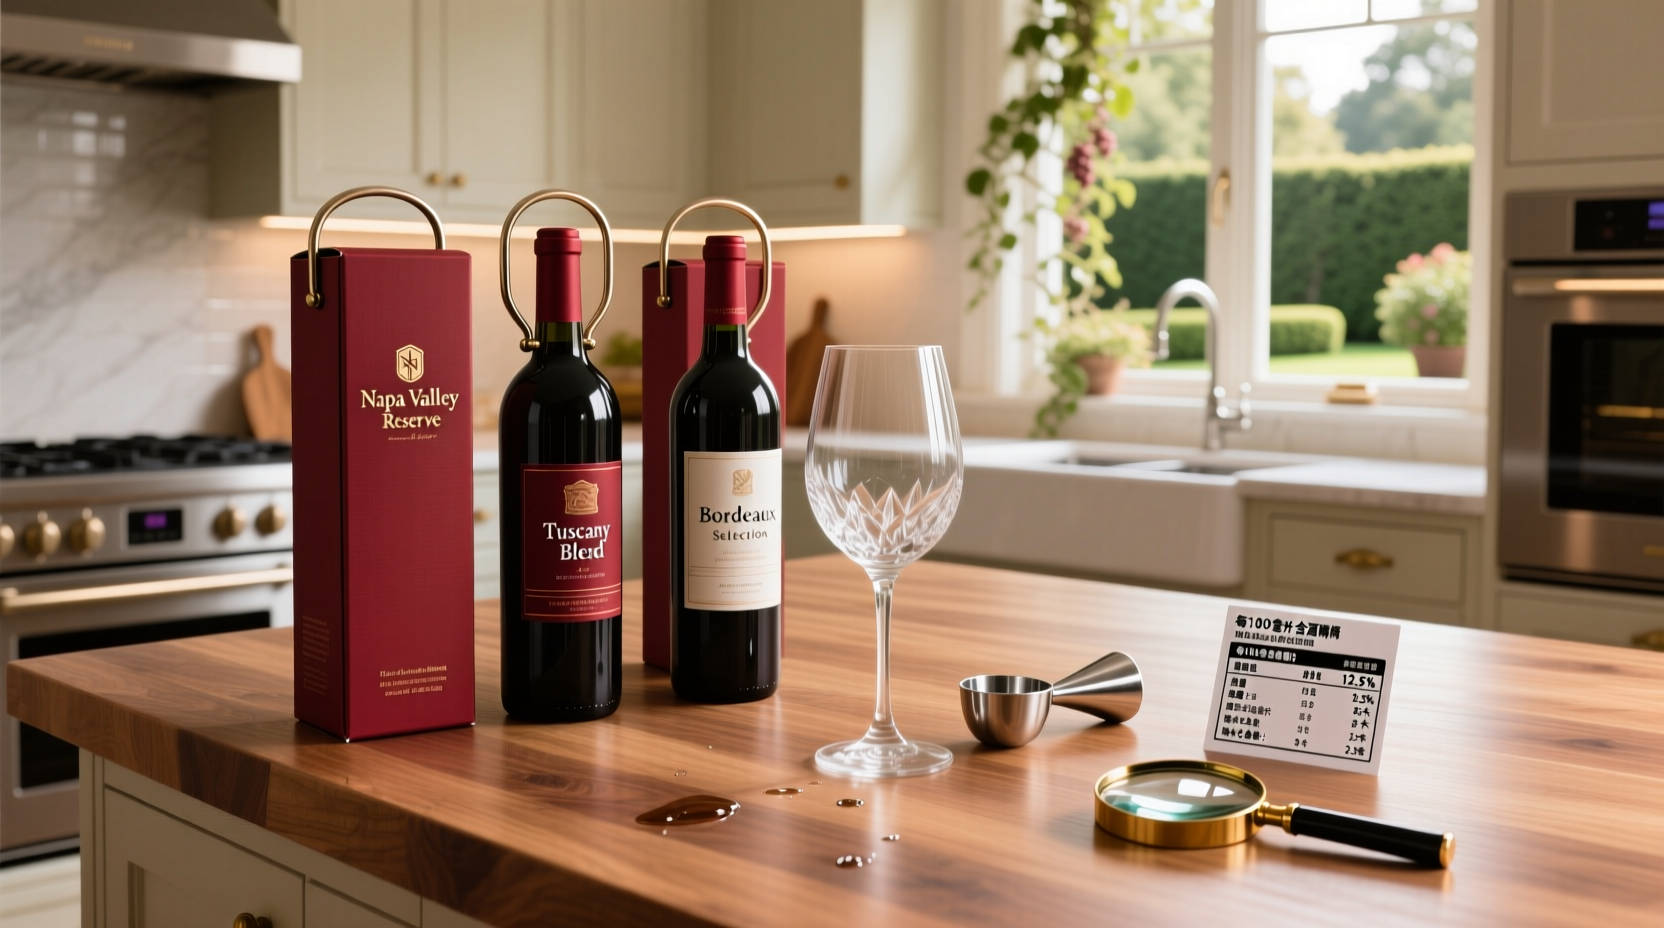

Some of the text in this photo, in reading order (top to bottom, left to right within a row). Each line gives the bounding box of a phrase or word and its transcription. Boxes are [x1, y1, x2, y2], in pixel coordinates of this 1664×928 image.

[360, 387, 459, 413] Napa Valley
[381, 413, 442, 429] Reserve
[699, 505, 777, 523] Bordeaux
[542, 521, 611, 543] Tuscany
[1342, 674, 1376, 689] 12.5%
